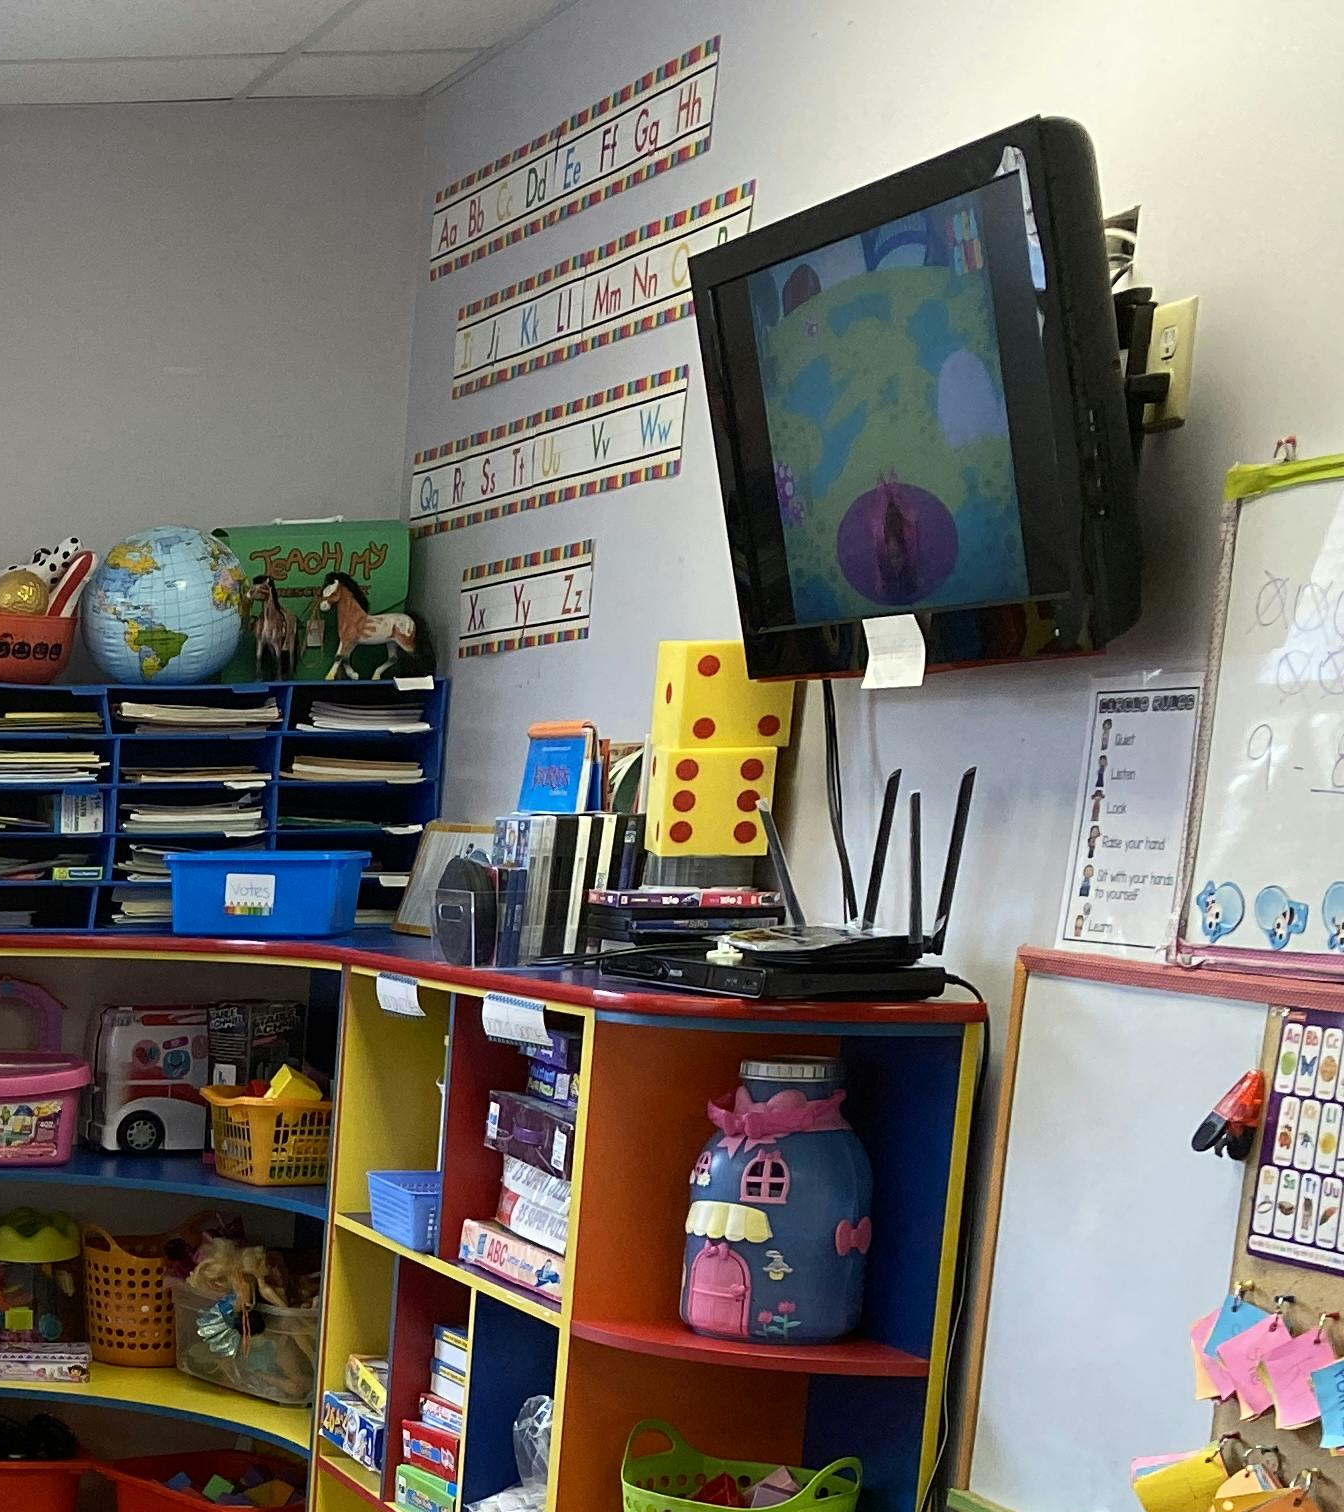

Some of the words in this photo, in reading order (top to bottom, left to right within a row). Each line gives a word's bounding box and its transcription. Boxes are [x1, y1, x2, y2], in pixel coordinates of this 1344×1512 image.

[439, 217, 457, 251] Aa
[468, 199, 485, 237] Bb
[526, 160, 547, 208] Dd
[564, 147, 582, 189] Ee
[600, 124, 619, 173] Ff
[634, 109, 659, 157] Gg
[676, 80, 701, 134] Hh
[487, 320, 499, 366] Jj
[520, 306, 539, 347] Kk
[557, 289, 572, 333] Ll
[592, 279, 621, 320] Mm
[632, 256, 657, 305] Nn
[420, 476, 439, 524] Qq
[453, 467, 465, 504] Rr
[481, 458, 496, 495] Ss
[513, 448, 524, 487] Tt
[541, 437, 561, 477] Uu
[592, 421, 610, 461] Vv
[640, 404, 671, 449] Ww
[467, 593, 486, 632] Xx
[514, 584, 531, 639] Yy
[561, 573, 582, 615] Zz
[1247, 724, 1275, 790] 9
[1111, 768, 1136, 780] Listen
[1106, 802, 1127, 815] Look
[1102, 834, 1122, 848] Raise
[1124, 840, 1144, 852] your
[1145, 837, 1166, 850] hand
[230, 881, 271, 899] Votes
[1128, 874, 1148, 887] your
[1150, 873, 1174, 886] hands
[1285, 1027, 1300, 1044] Aa
[1305, 1030, 1319, 1046] Bb
[1325, 1033, 1340, 1050] Cc
[1283, 1173, 1297, 1190] Ss
[1304, 1177, 1318, 1194] Tt
[1323, 1181, 1341, 1198] Uu
[487, 1238, 509, 1267] ABC
